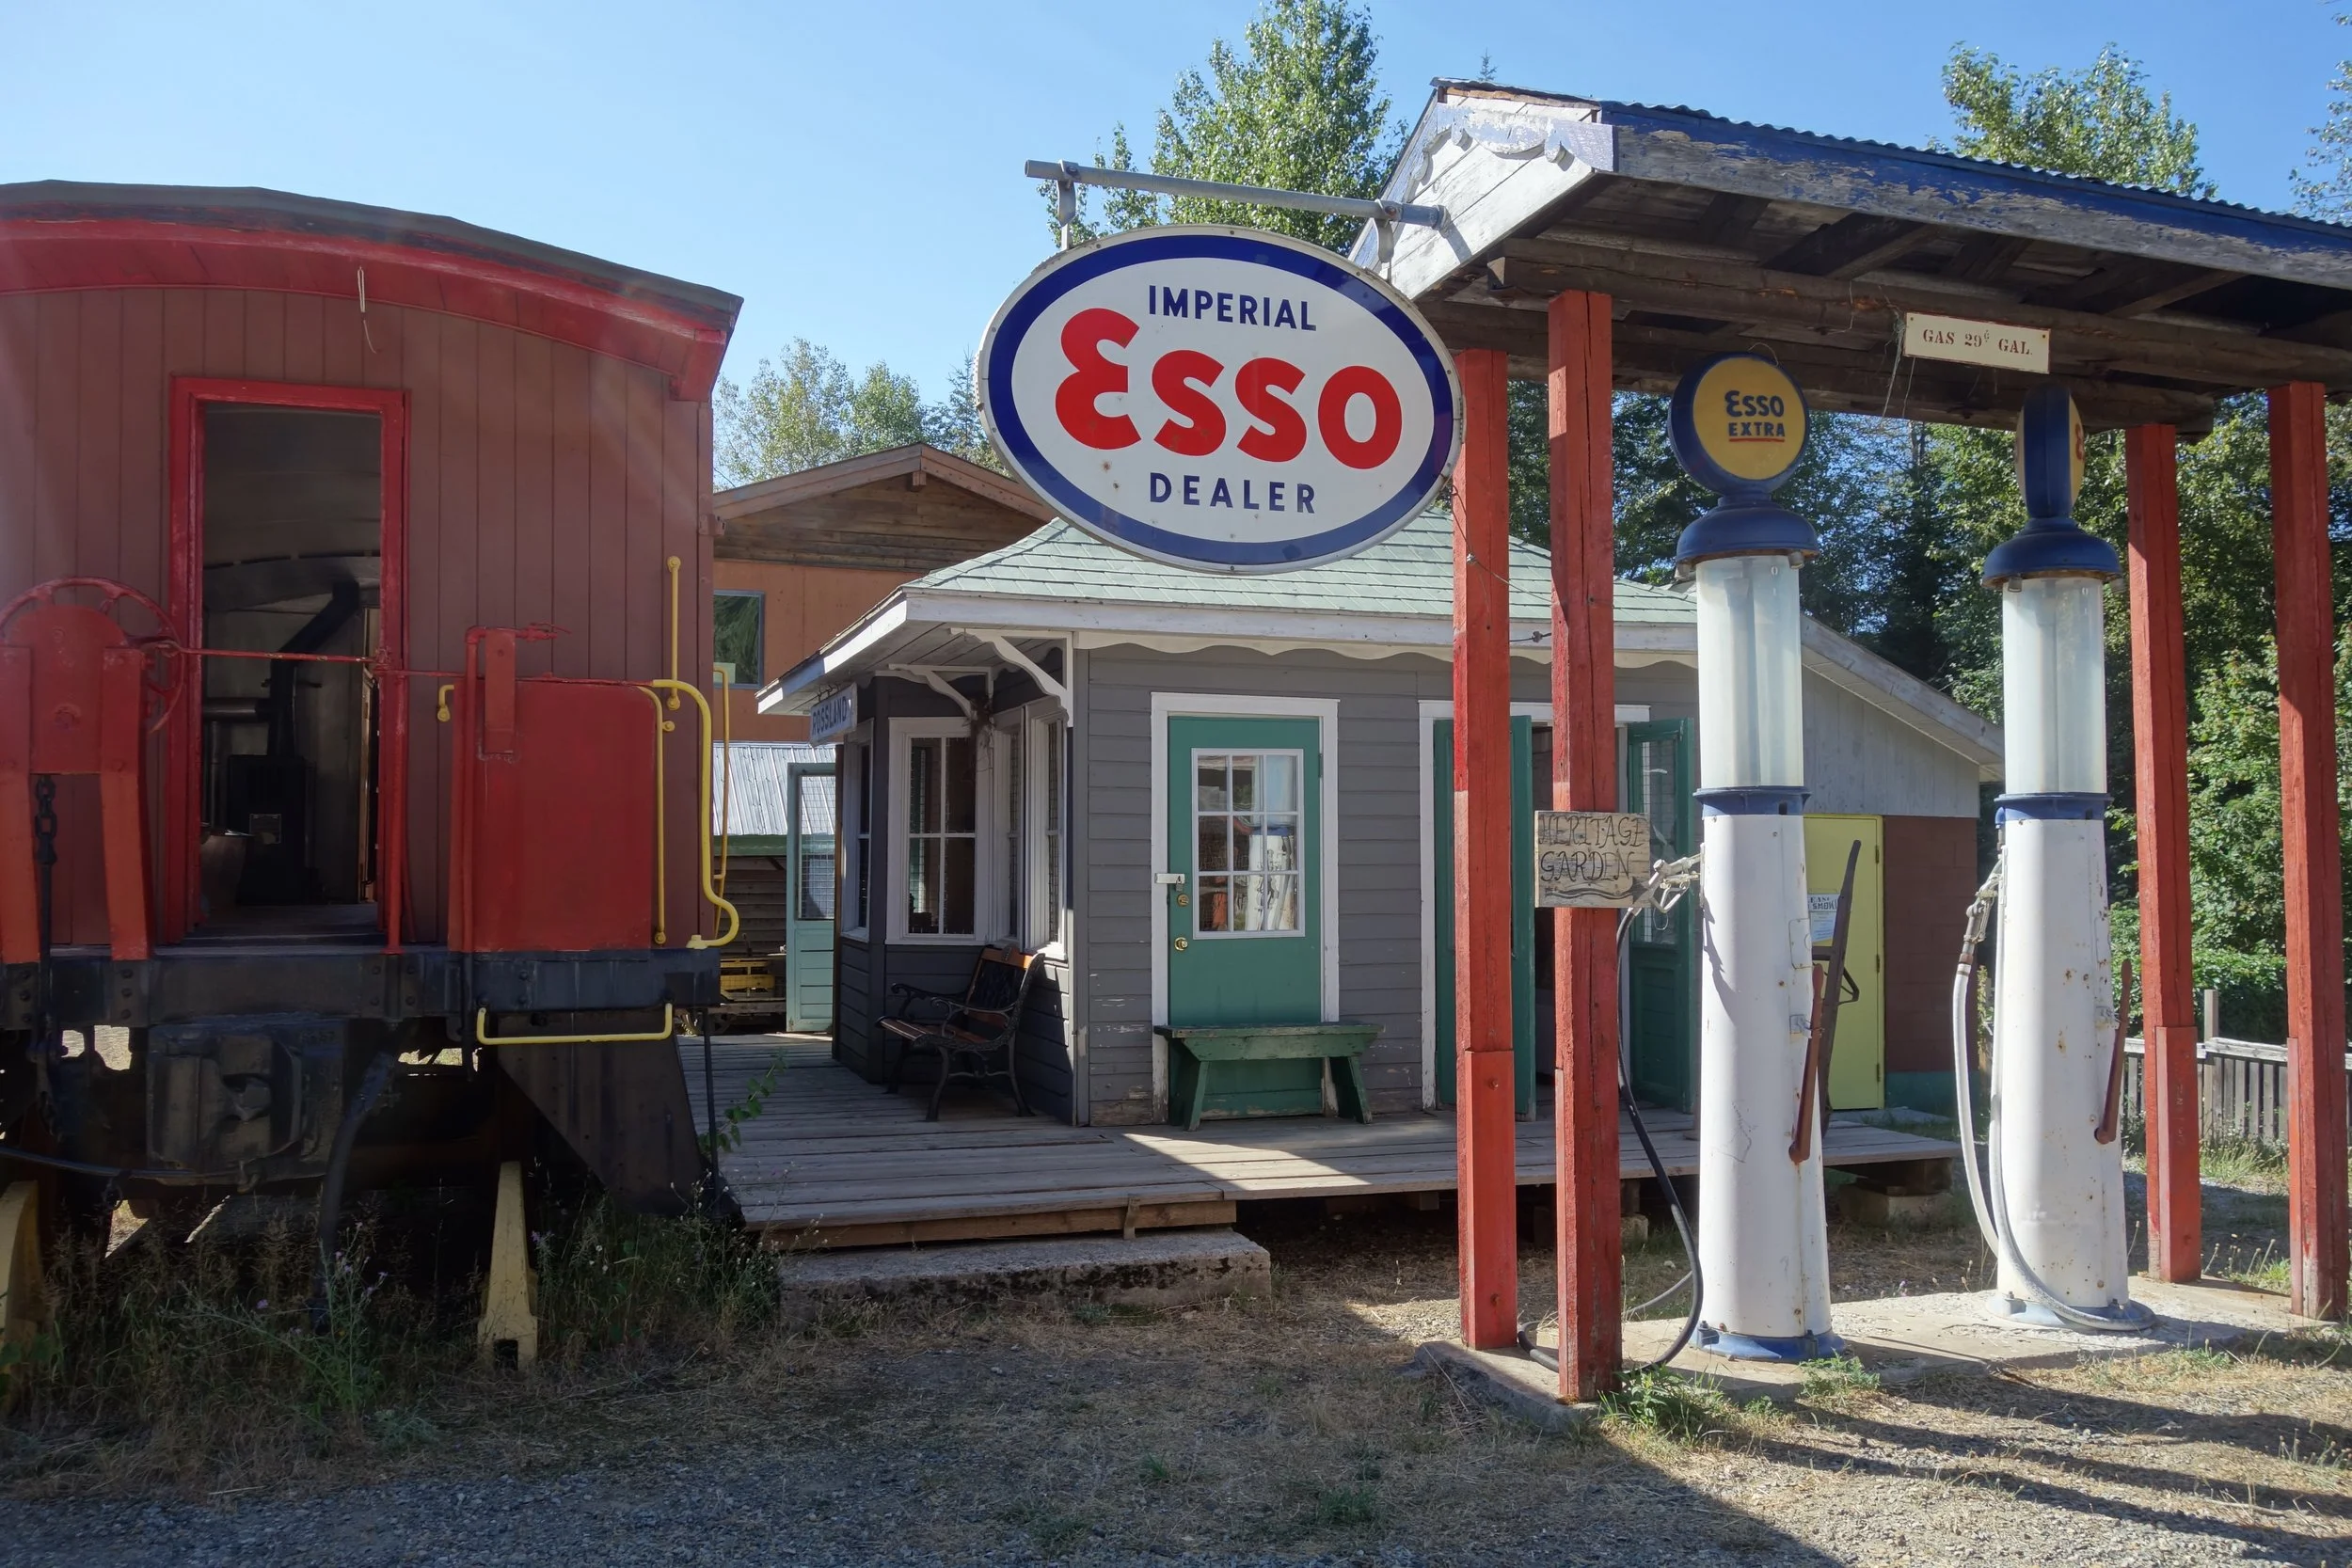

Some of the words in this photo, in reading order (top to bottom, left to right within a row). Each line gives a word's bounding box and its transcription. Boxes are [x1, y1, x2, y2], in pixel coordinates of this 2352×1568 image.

[1149, 285, 1316, 331] IMPERIAL
[1923, 329, 1955, 345] GAS
[1998, 338, 2033, 356] GAL.
[1055, 308, 1403, 469] ESSO
[1724, 390, 1785, 418] ESSO
[1729, 422, 1785, 437] EXTRA
[1151, 472, 1315, 514] DEALER
[812, 695, 847, 736] ROSSLAND
[1538, 815, 1647, 847] HERITAGE
[1540, 851, 1632, 881] GARDEN
